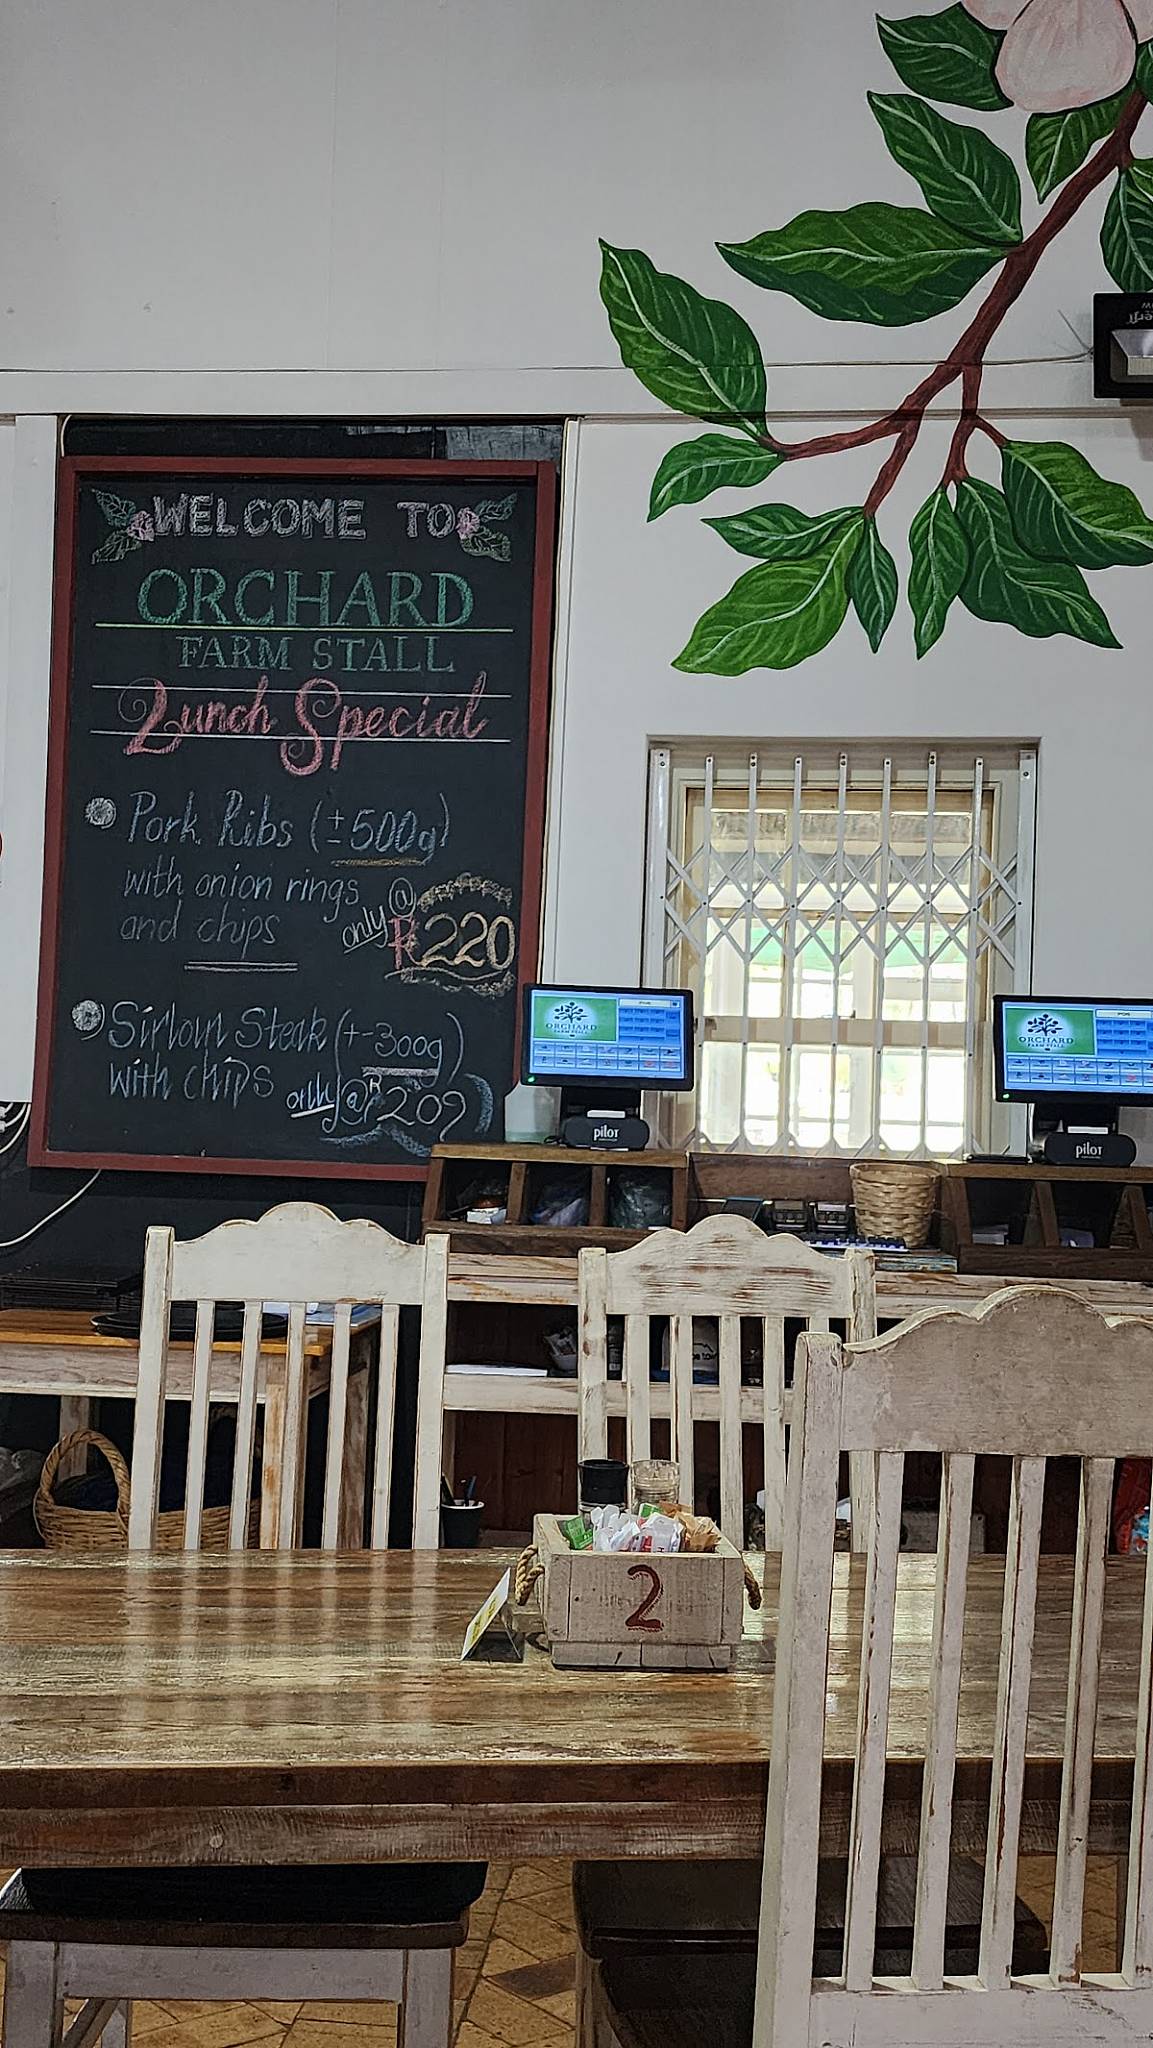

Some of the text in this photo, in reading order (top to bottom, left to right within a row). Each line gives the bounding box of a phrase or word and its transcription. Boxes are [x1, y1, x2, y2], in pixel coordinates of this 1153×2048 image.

[152, 493, 458, 540] WELCOME TO
[137, 567, 474, 628] ORCHARD
[176, 635, 457, 673] FARM STALL
[118, 670, 489, 776] Lunch Special
[127, 791, 201, 843] Pork
[217, 789, 294, 848] Ribs
[124, 854, 360, 923] with onion rings
[120, 900, 281, 960] and chips
[342, 905, 389, 953] only
[388, 911, 516, 970] R220
[108, 1001, 229, 1051] Sirloin
[235, 1006, 327, 1052] Steak
[545, 1022, 597, 1031] ORCHARD
[1018, 1036, 1074, 1044] ORCHARD
[109, 1052, 173, 1100] with
[286, 1072, 341, 1133] only
[625, 1563, 665, 1633] 2
